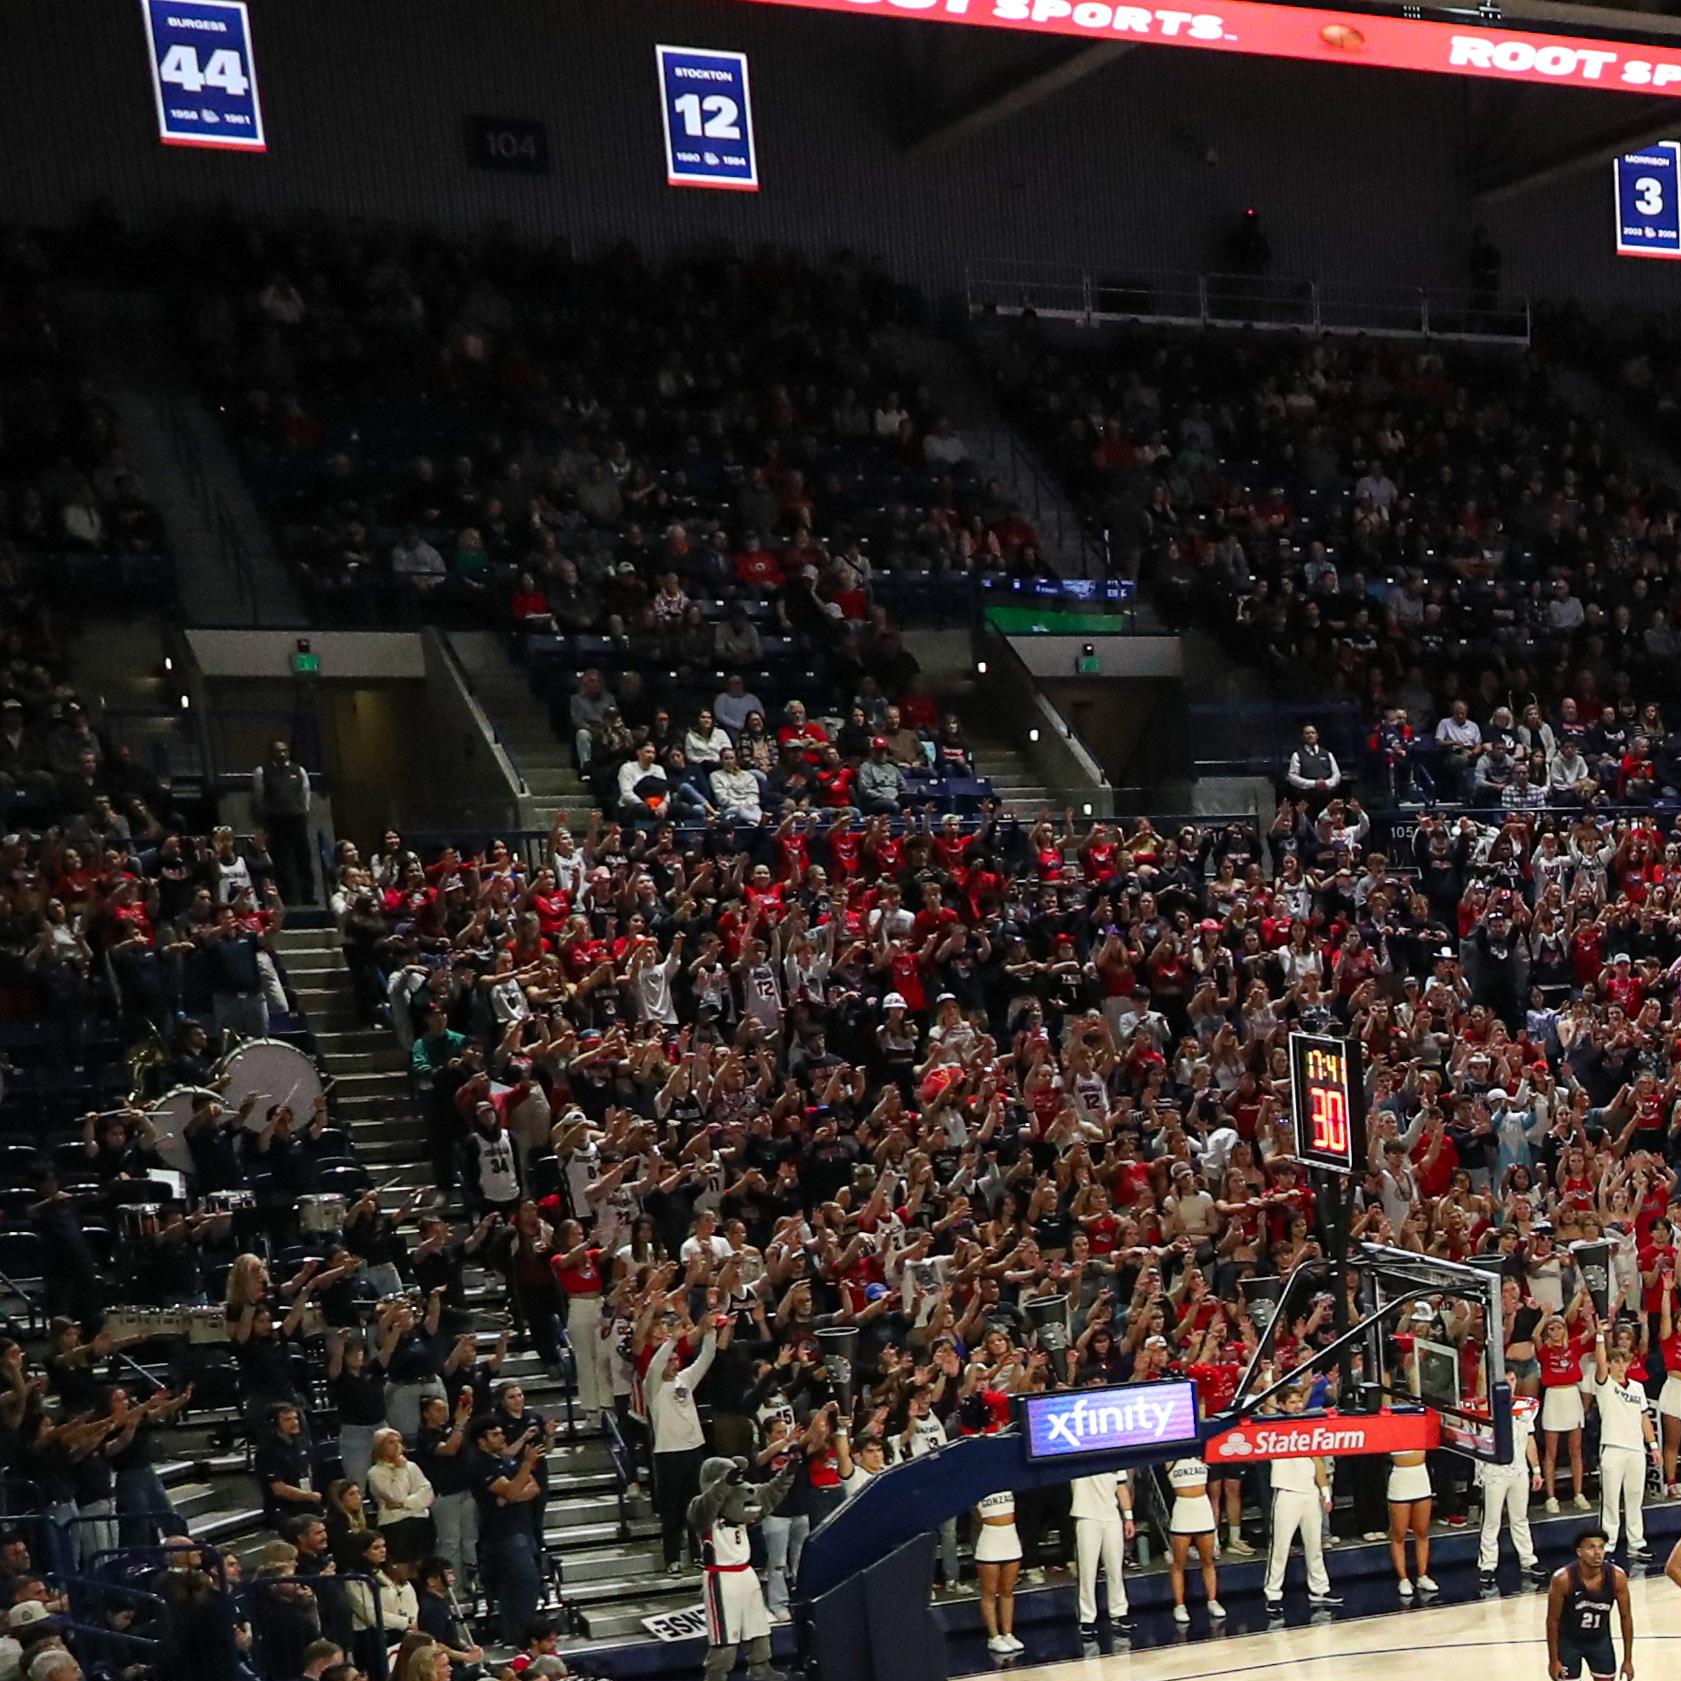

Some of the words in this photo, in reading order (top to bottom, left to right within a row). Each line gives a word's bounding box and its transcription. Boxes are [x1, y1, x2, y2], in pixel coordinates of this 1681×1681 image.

[167, 17, 228, 32] BURGESS
[992, 0, 1224, 40] SPORTS
[160, 44, 249, 96] 44
[1450, 36, 1617, 79] ROOT
[674, 93, 741, 140] 12
[485, 131, 537, 160] 104
[1635, 177, 1664, 215] 3
[1390, 826, 1414, 839] 105
[1308, 1087, 1346, 1153] 30
[1047, 1396, 1173, 1447] xfinity
[1580, 1612, 1602, 1630] 21
